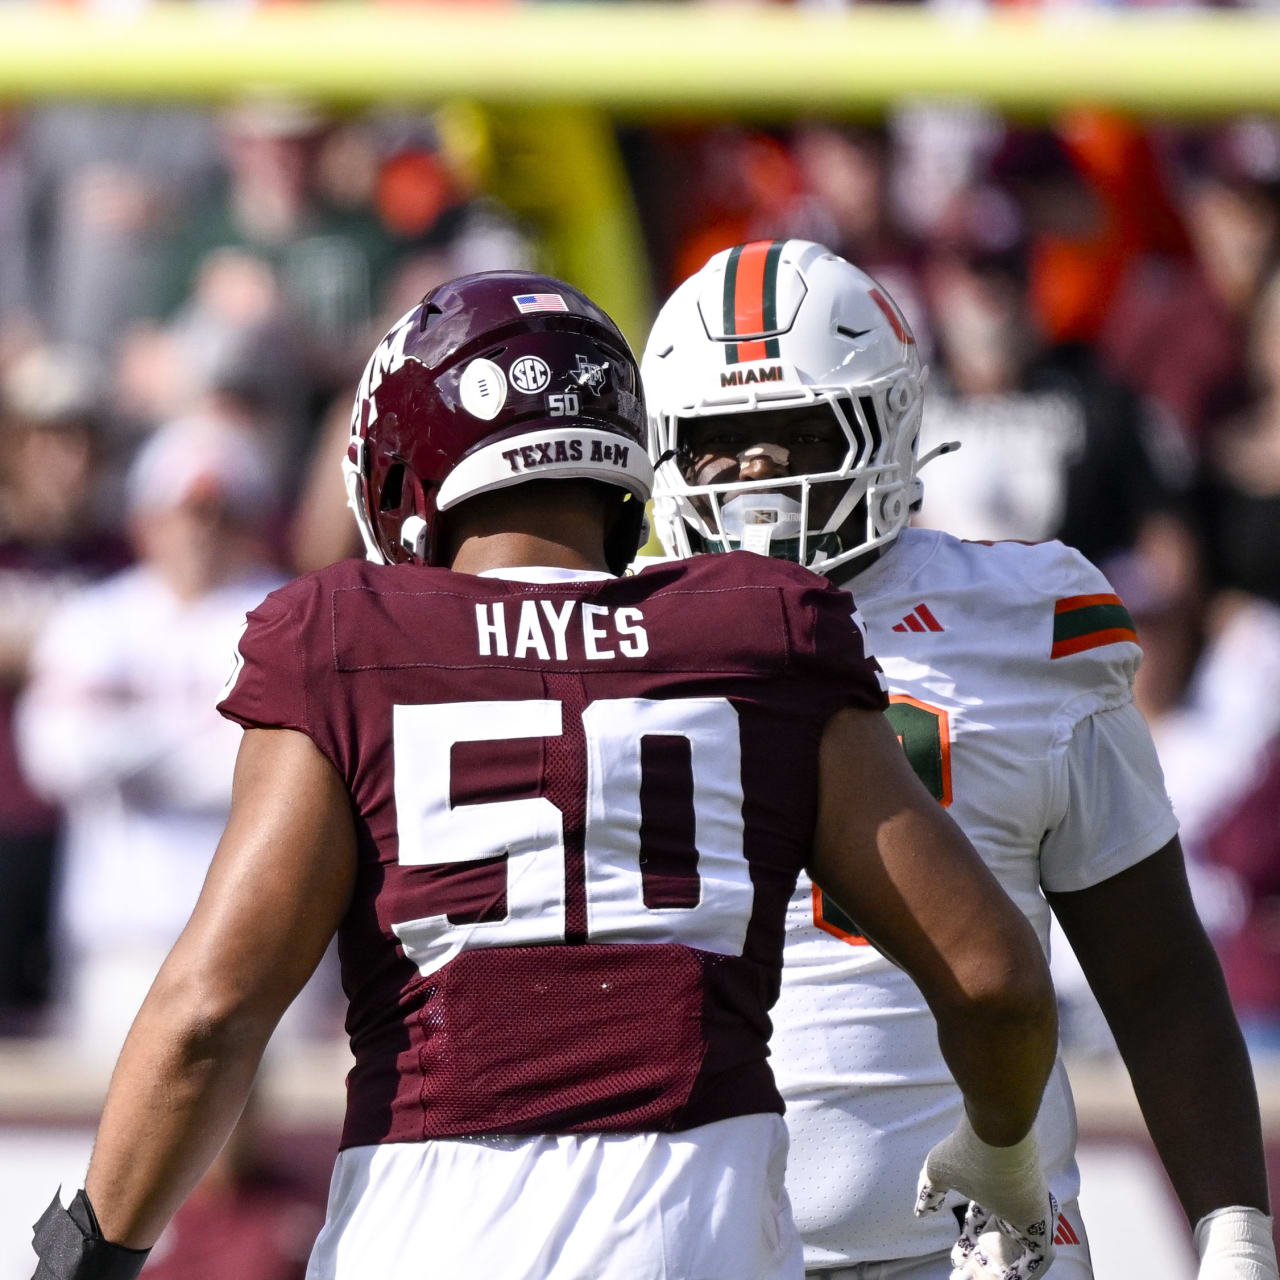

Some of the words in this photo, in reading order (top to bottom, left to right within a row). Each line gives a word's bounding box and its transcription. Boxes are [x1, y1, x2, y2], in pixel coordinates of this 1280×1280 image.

[514, 363, 547, 390] SEC
[720, 366, 783, 387] MIAMI
[548, 394, 580, 416] 50
[502, 440, 582, 472] TEXAS
[590, 440, 630, 468] A&M
[475, 600, 649, 660] HAYES
[392, 697, 755, 976] 50
